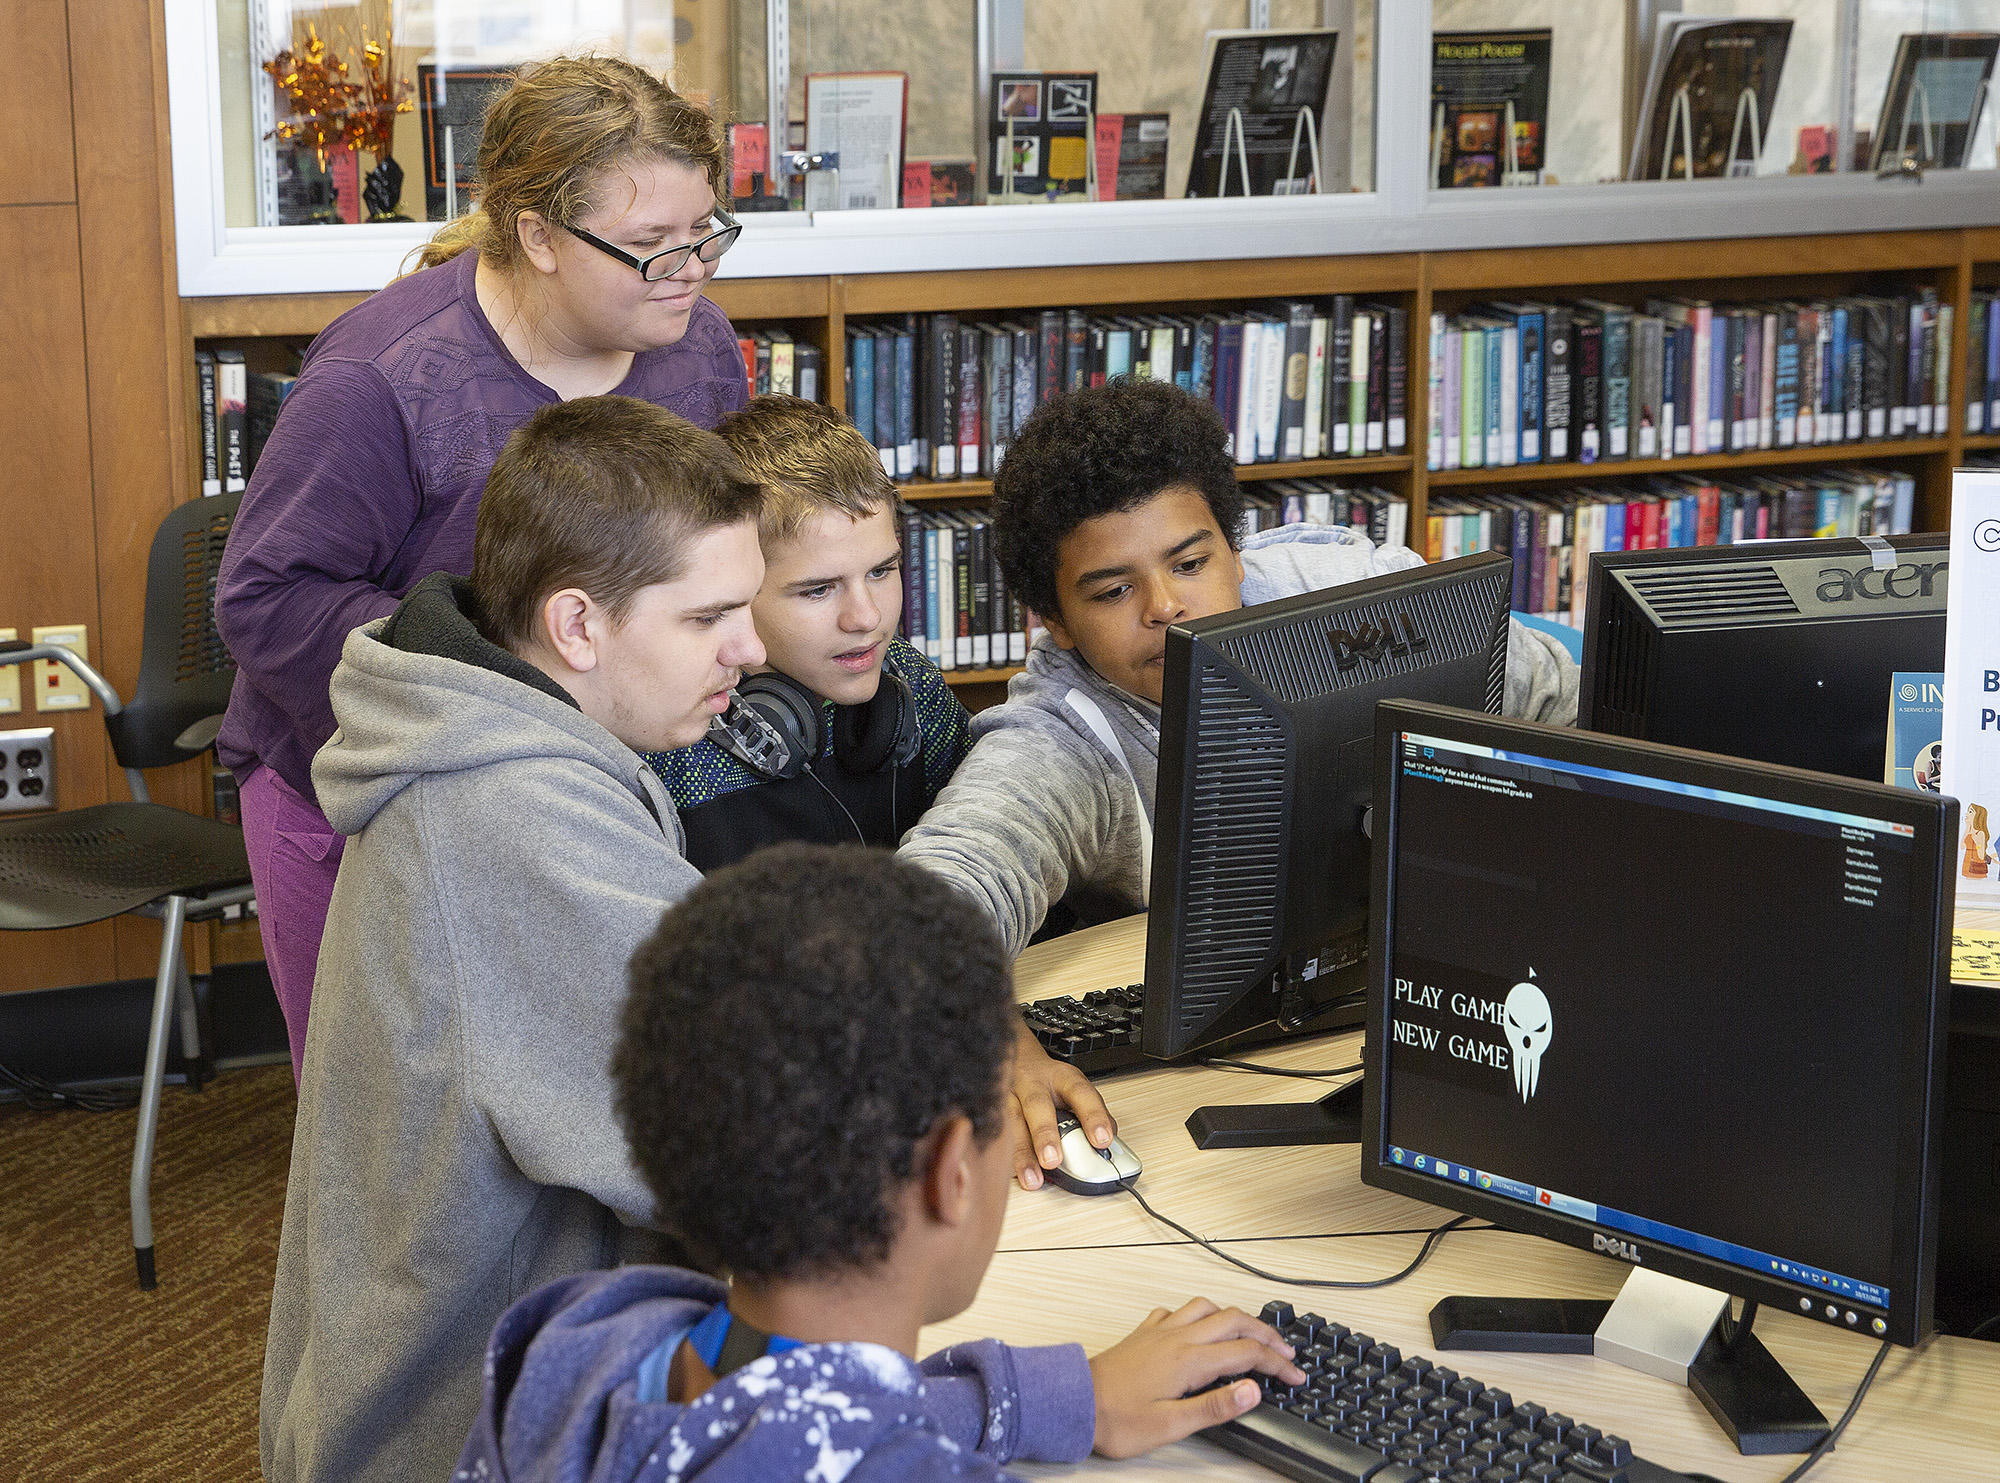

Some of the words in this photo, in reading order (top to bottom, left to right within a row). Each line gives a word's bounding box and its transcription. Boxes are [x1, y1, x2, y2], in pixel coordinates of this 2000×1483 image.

[1816, 561, 1949, 602] acer
[1326, 612, 1429, 673] DELL
[1445, 777, 1464, 786] anyone
[1464, 780, 1477, 788] need
[1482, 784, 1502, 793] weapon
[1510, 789, 1525, 798] grade
[1475, 774, 1487, 782] chat
[1394, 978, 1443, 1010] PLAY
[1451, 993, 1505, 1026] GAME
[1393, 1019, 1441, 1051] NEW
[1449, 1034, 1509, 1070] GAME
[1593, 1233, 1641, 1263] DELL
